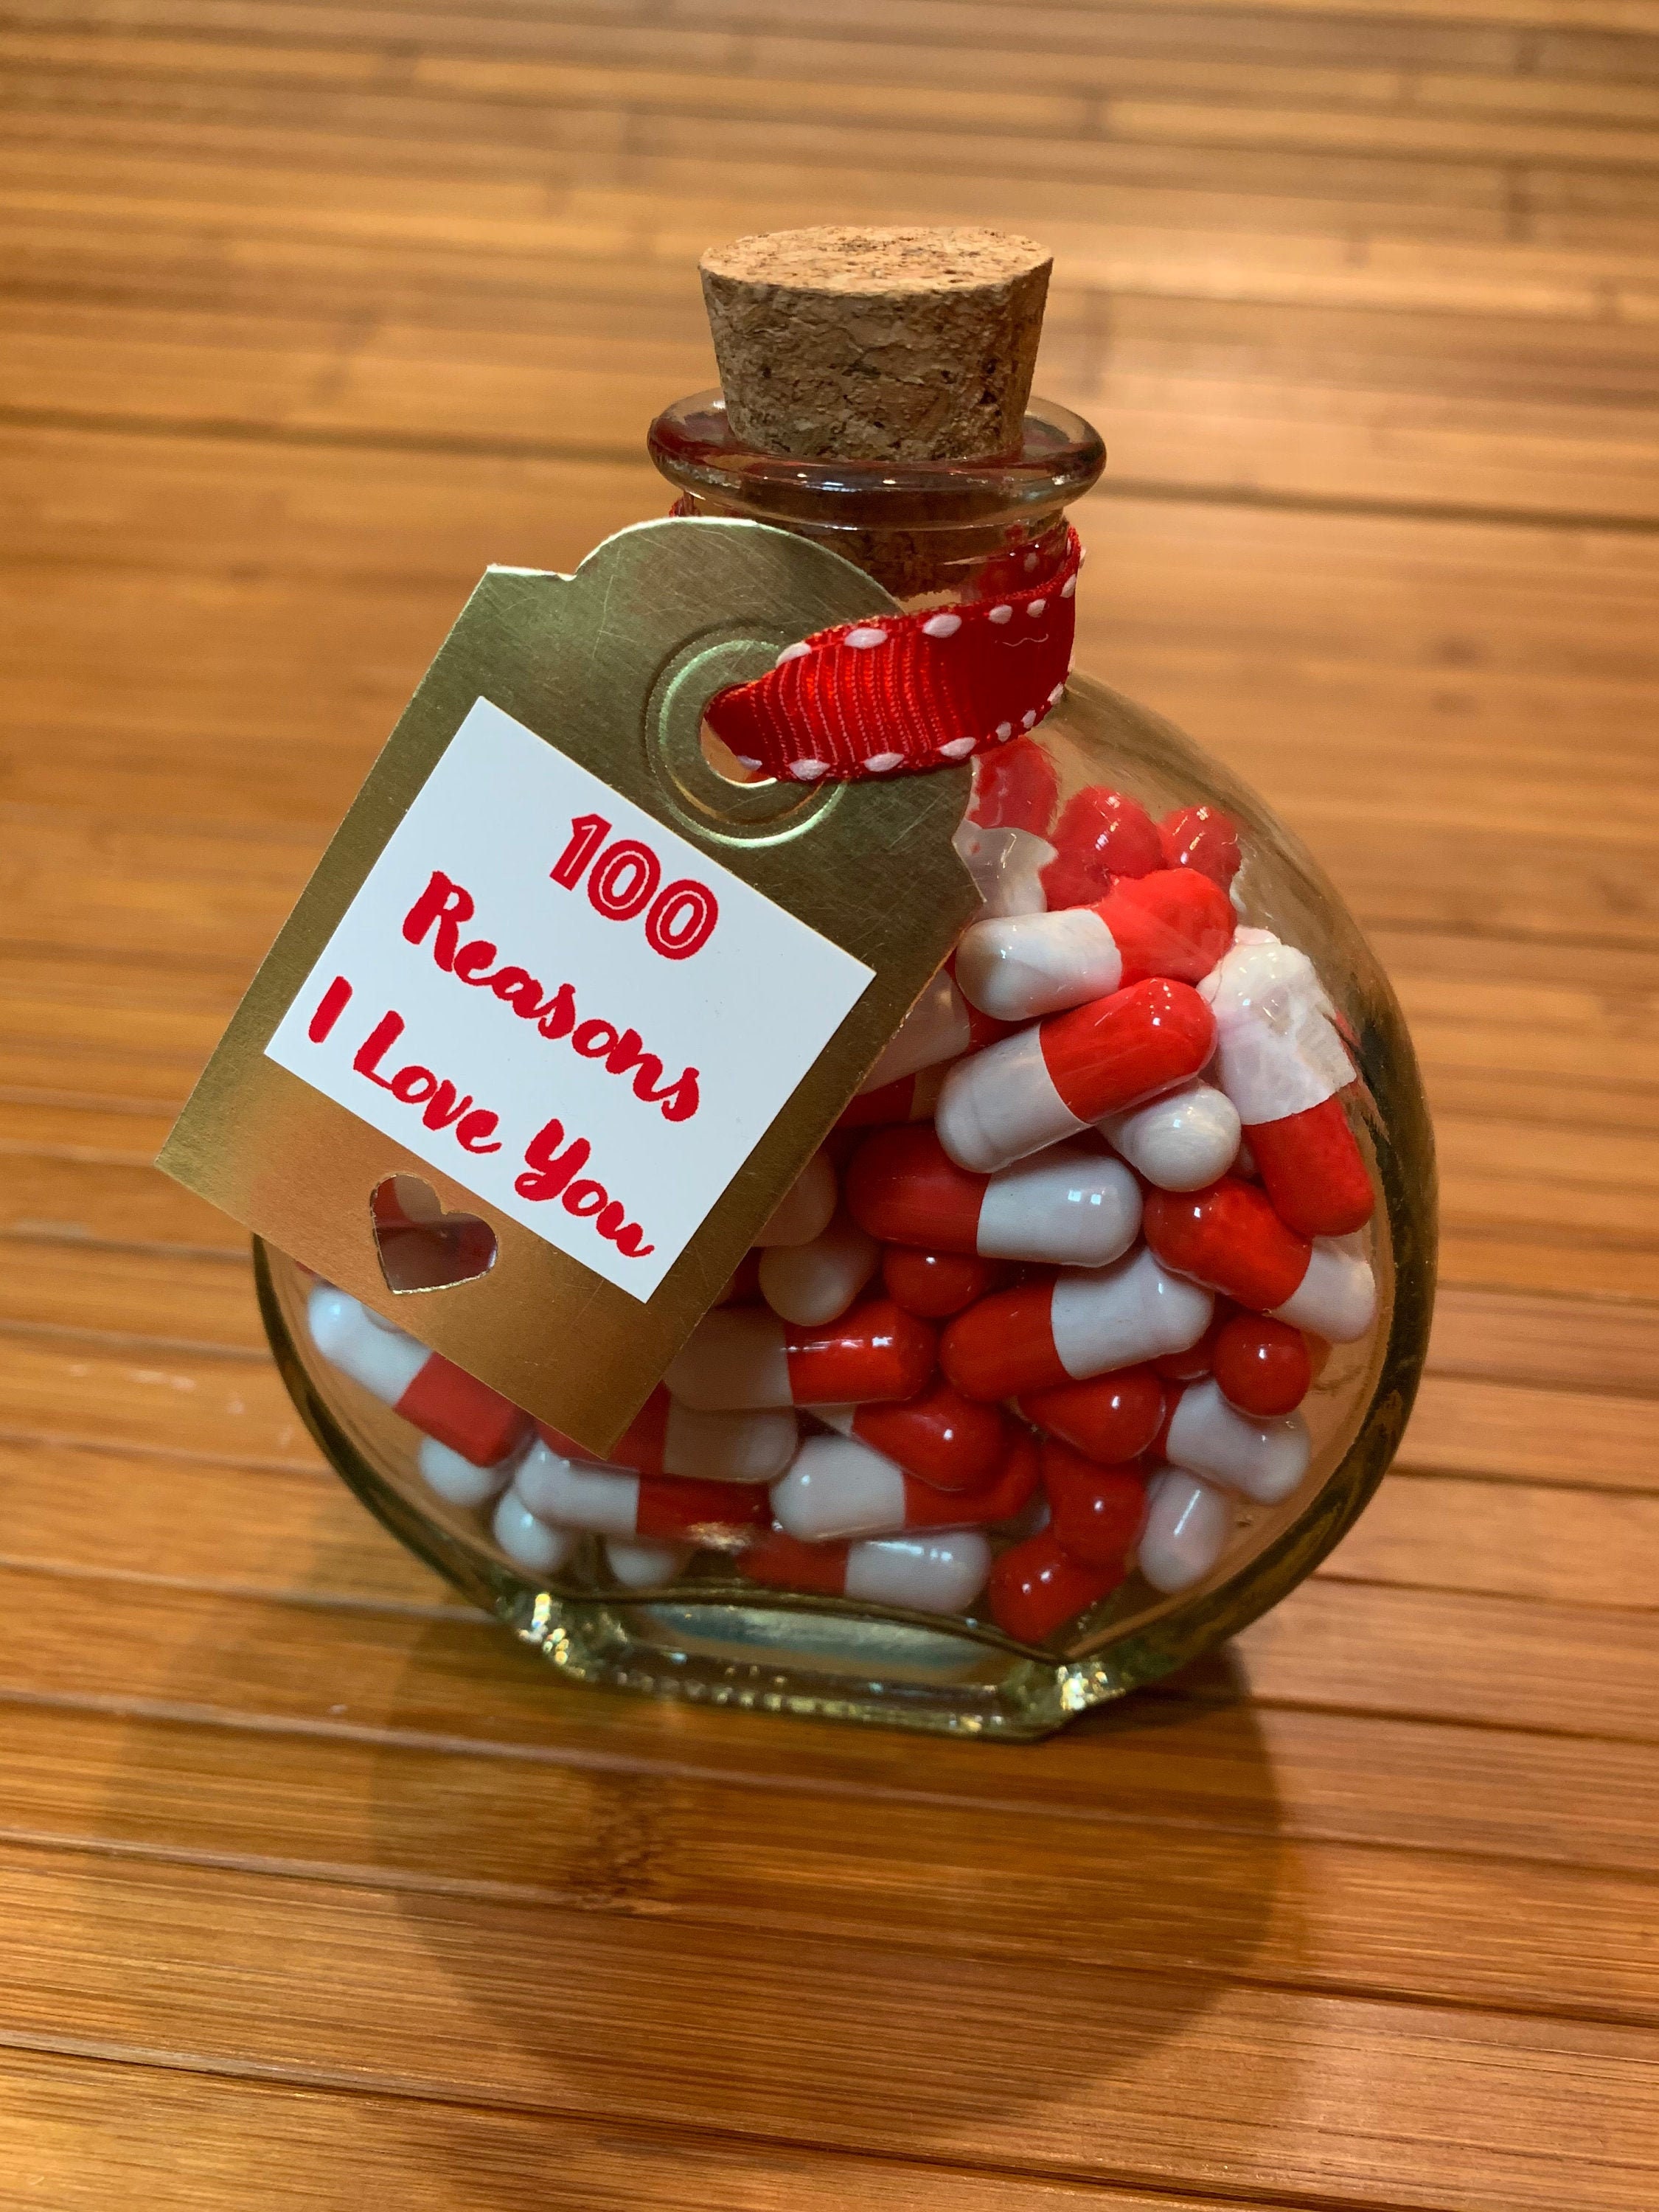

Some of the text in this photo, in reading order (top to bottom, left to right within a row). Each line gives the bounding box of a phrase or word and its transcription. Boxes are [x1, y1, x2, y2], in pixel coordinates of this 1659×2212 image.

[402, 870, 700, 1122] Reasons
[549, 813, 719, 961] 100
[308, 975, 655, 1258] I Love You
